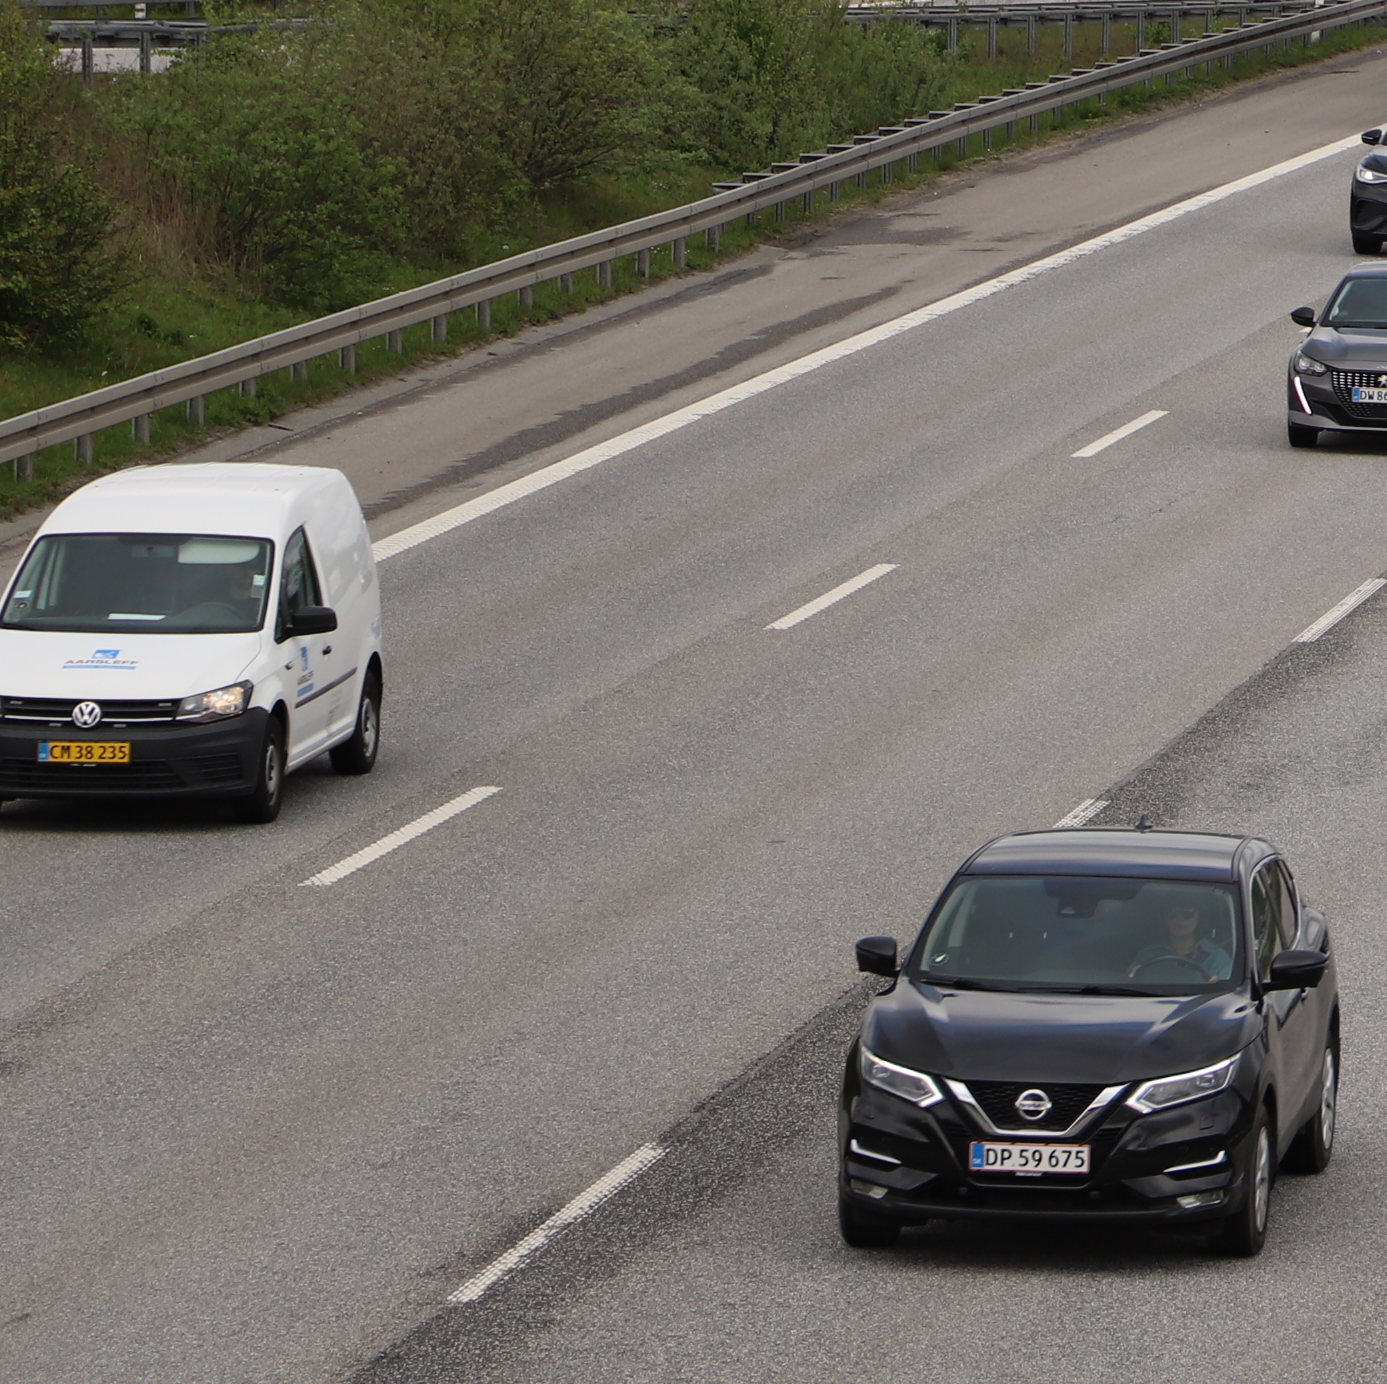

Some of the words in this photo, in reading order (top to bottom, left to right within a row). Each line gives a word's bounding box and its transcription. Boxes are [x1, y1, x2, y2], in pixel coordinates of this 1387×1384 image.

[49, 745, 71, 759] CM
[74, 745, 94, 759] 38
[97, 745, 127, 760] 235
[985, 1148, 1013, 1166] DP
[1018, 1149, 1043, 1168] 59
[1048, 1149, 1085, 1168] 675
